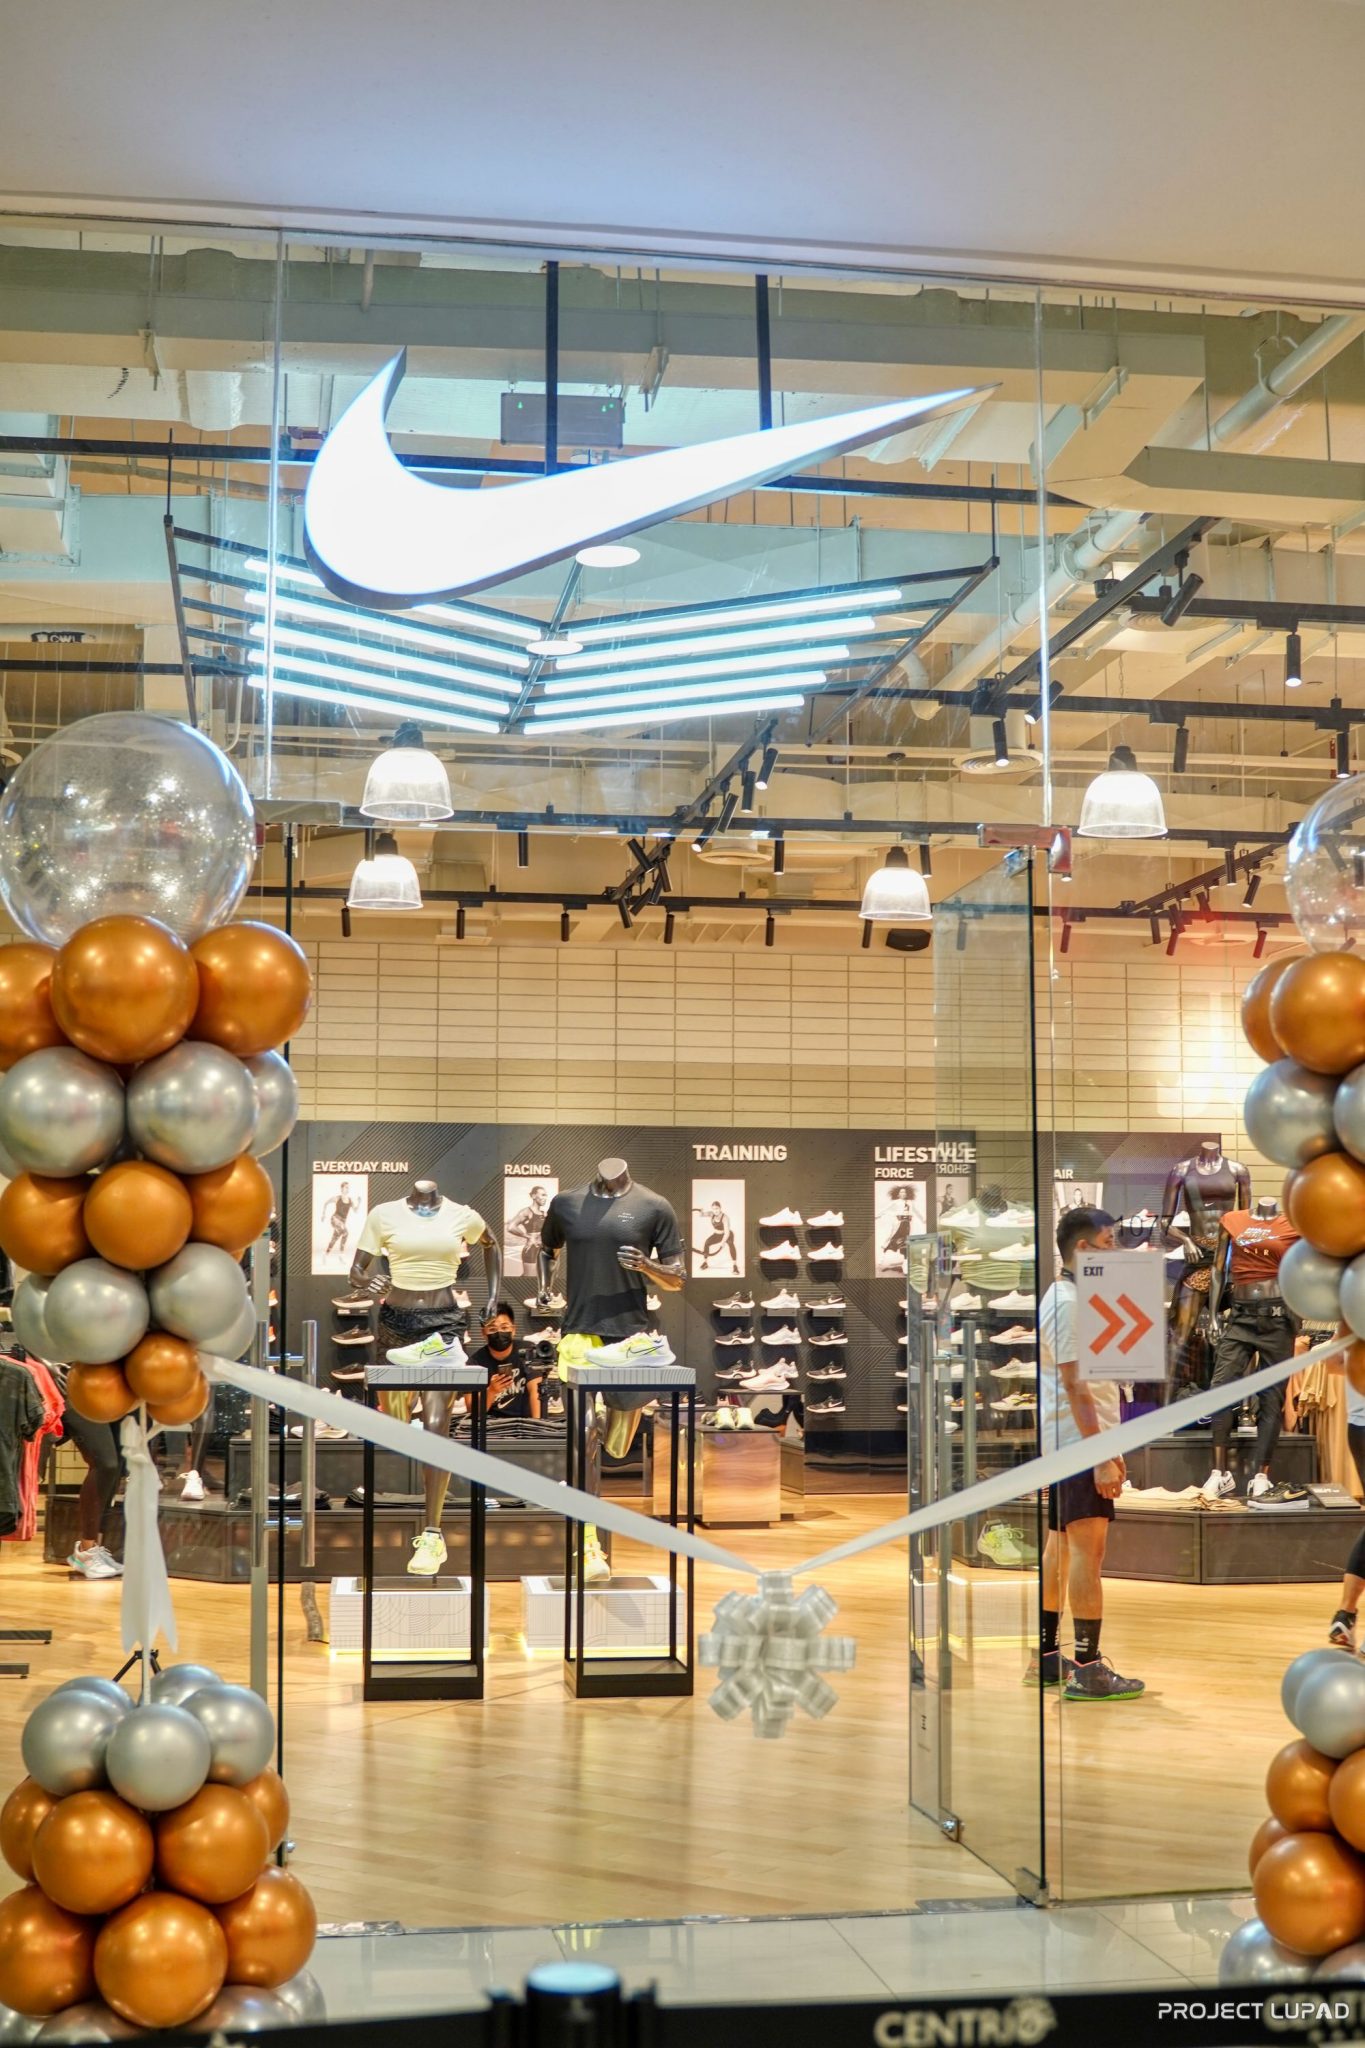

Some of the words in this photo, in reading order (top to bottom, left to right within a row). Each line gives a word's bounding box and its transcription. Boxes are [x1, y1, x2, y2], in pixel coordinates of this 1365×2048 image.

[692, 1144, 788, 1161] TRAINING
[874, 1146, 976, 1163] LIFESTYLE
[313, 1161, 379, 1172] EVERYDAY
[382, 1162, 408, 1172] RUN
[504, 1164, 551, 1175] RACING
[874, 1167, 914, 1178] FORCE
[1053, 1169, 1074, 1179] AIR
[1116, 1214, 1175, 1243] 1077
[1083, 1266, 1104, 1277] EXIT
